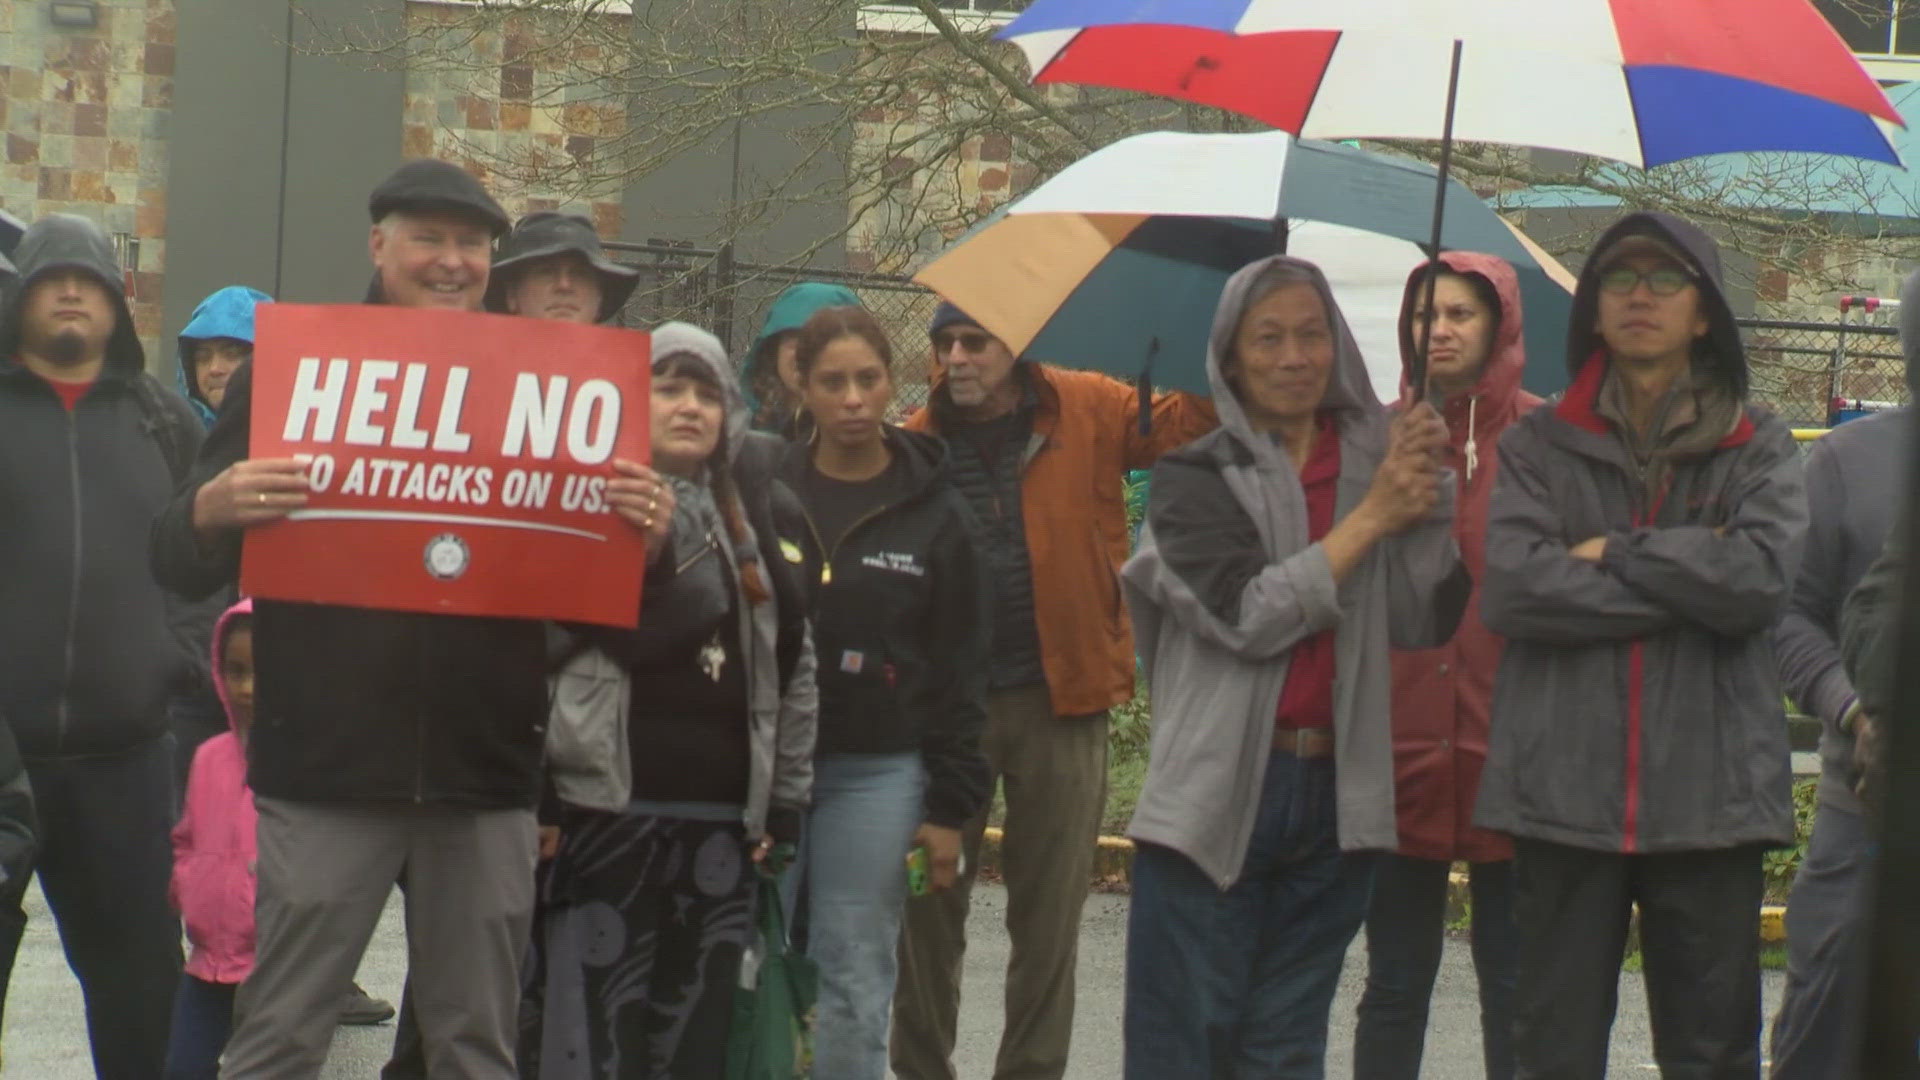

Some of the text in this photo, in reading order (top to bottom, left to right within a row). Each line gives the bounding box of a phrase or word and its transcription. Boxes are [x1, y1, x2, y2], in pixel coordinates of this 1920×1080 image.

[282, 357, 622, 465] HELL NO
[340, 457, 494, 505] ATTACKS
[501, 469, 554, 509] ON
